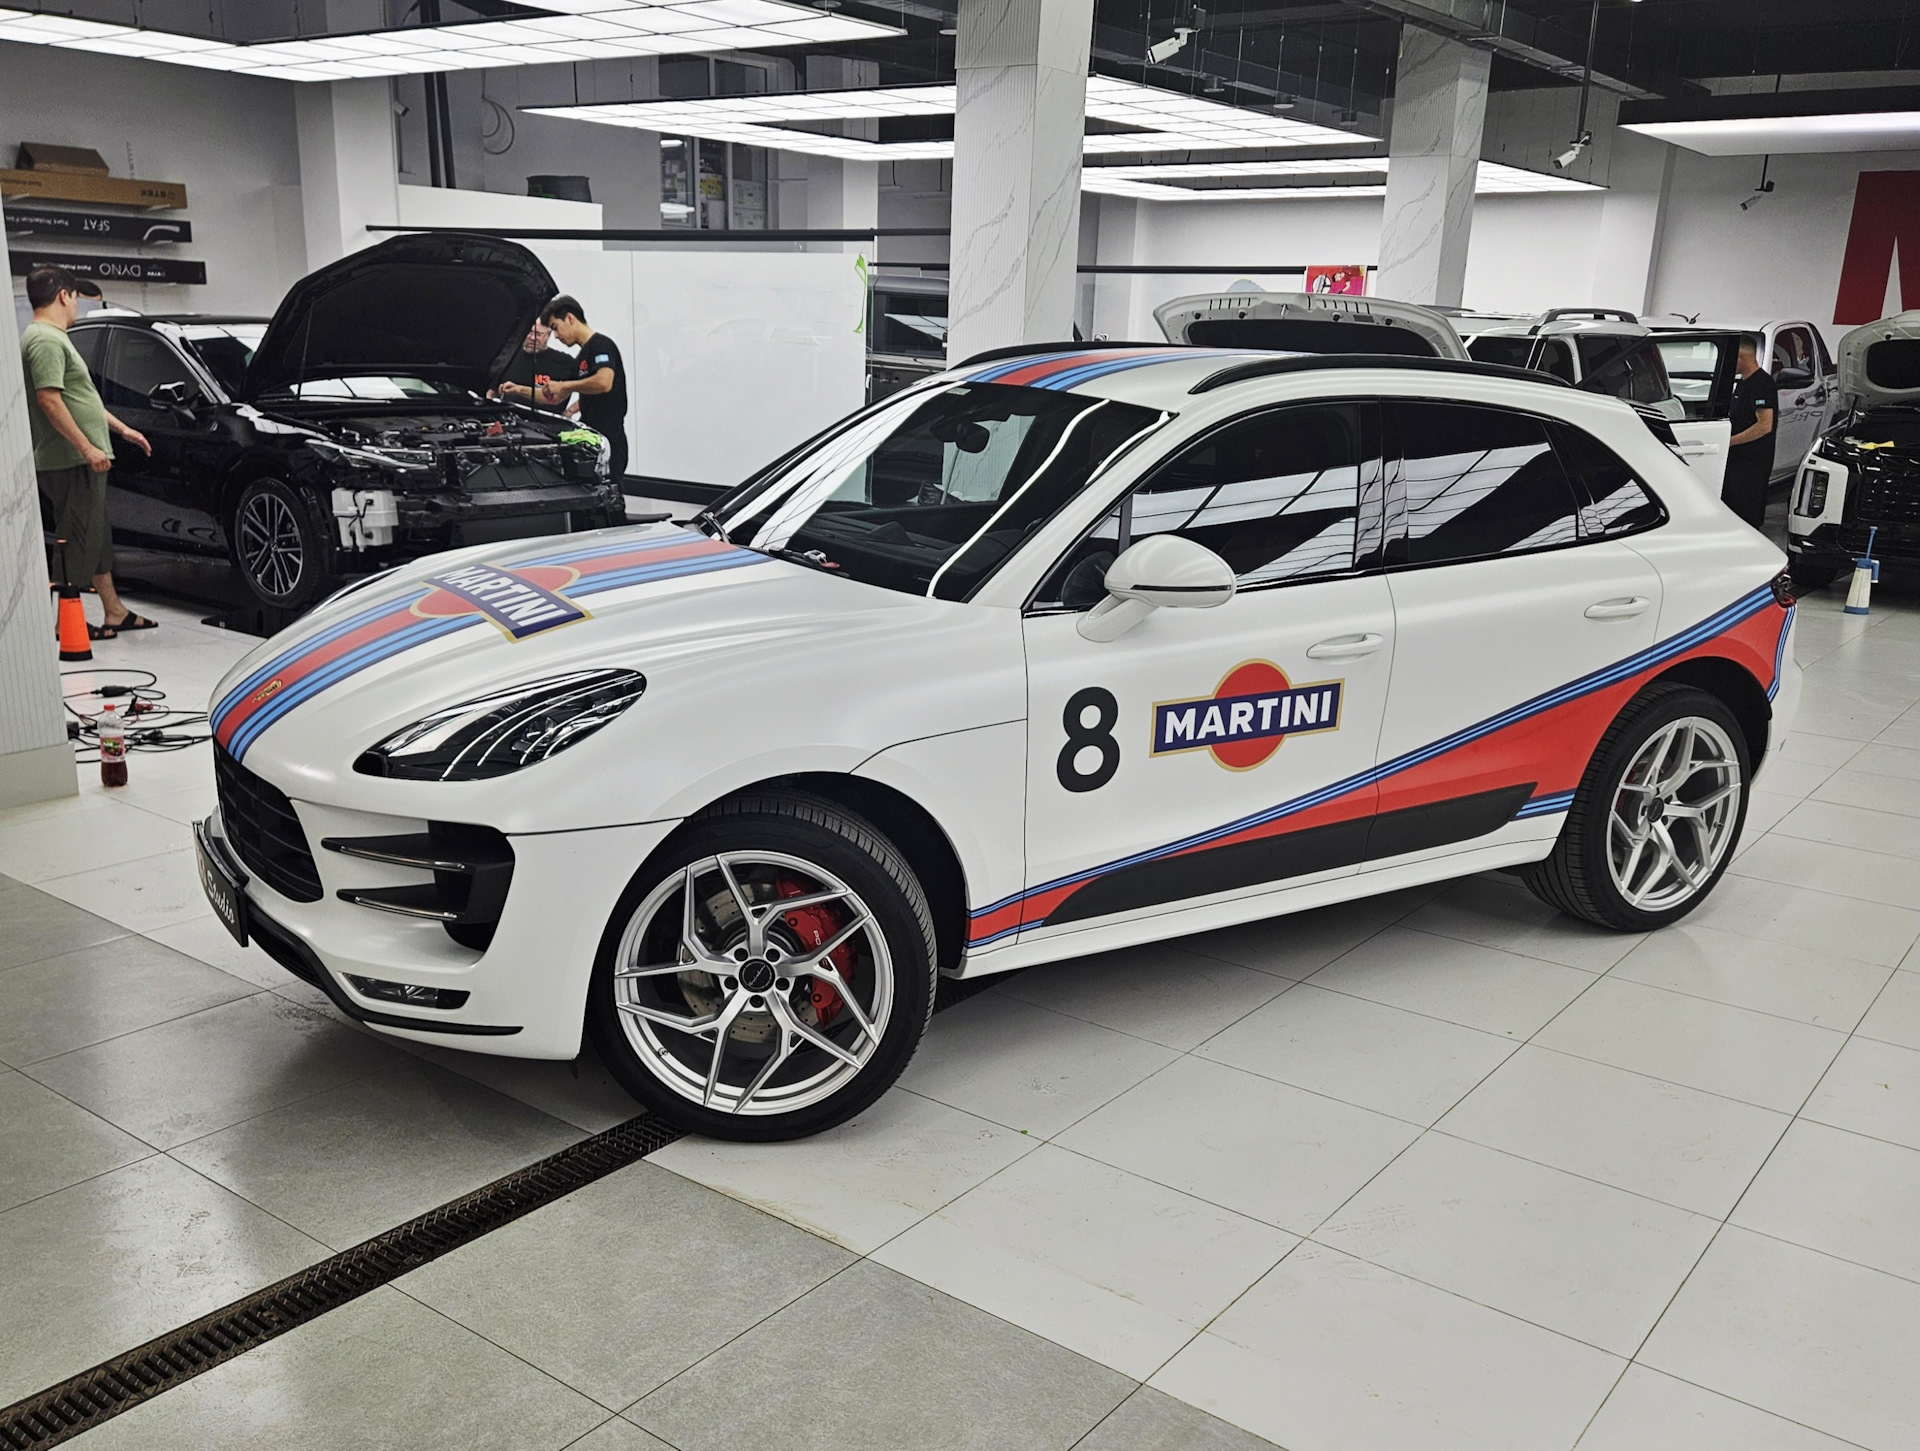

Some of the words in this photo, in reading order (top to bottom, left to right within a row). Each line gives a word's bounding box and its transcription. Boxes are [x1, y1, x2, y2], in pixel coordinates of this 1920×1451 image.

[99, 262, 141, 278] DYNO
[433, 565, 567, 627] MARTINI
[1056, 686, 1121, 792] 8
[1164, 690, 1332, 744] MARTINI
